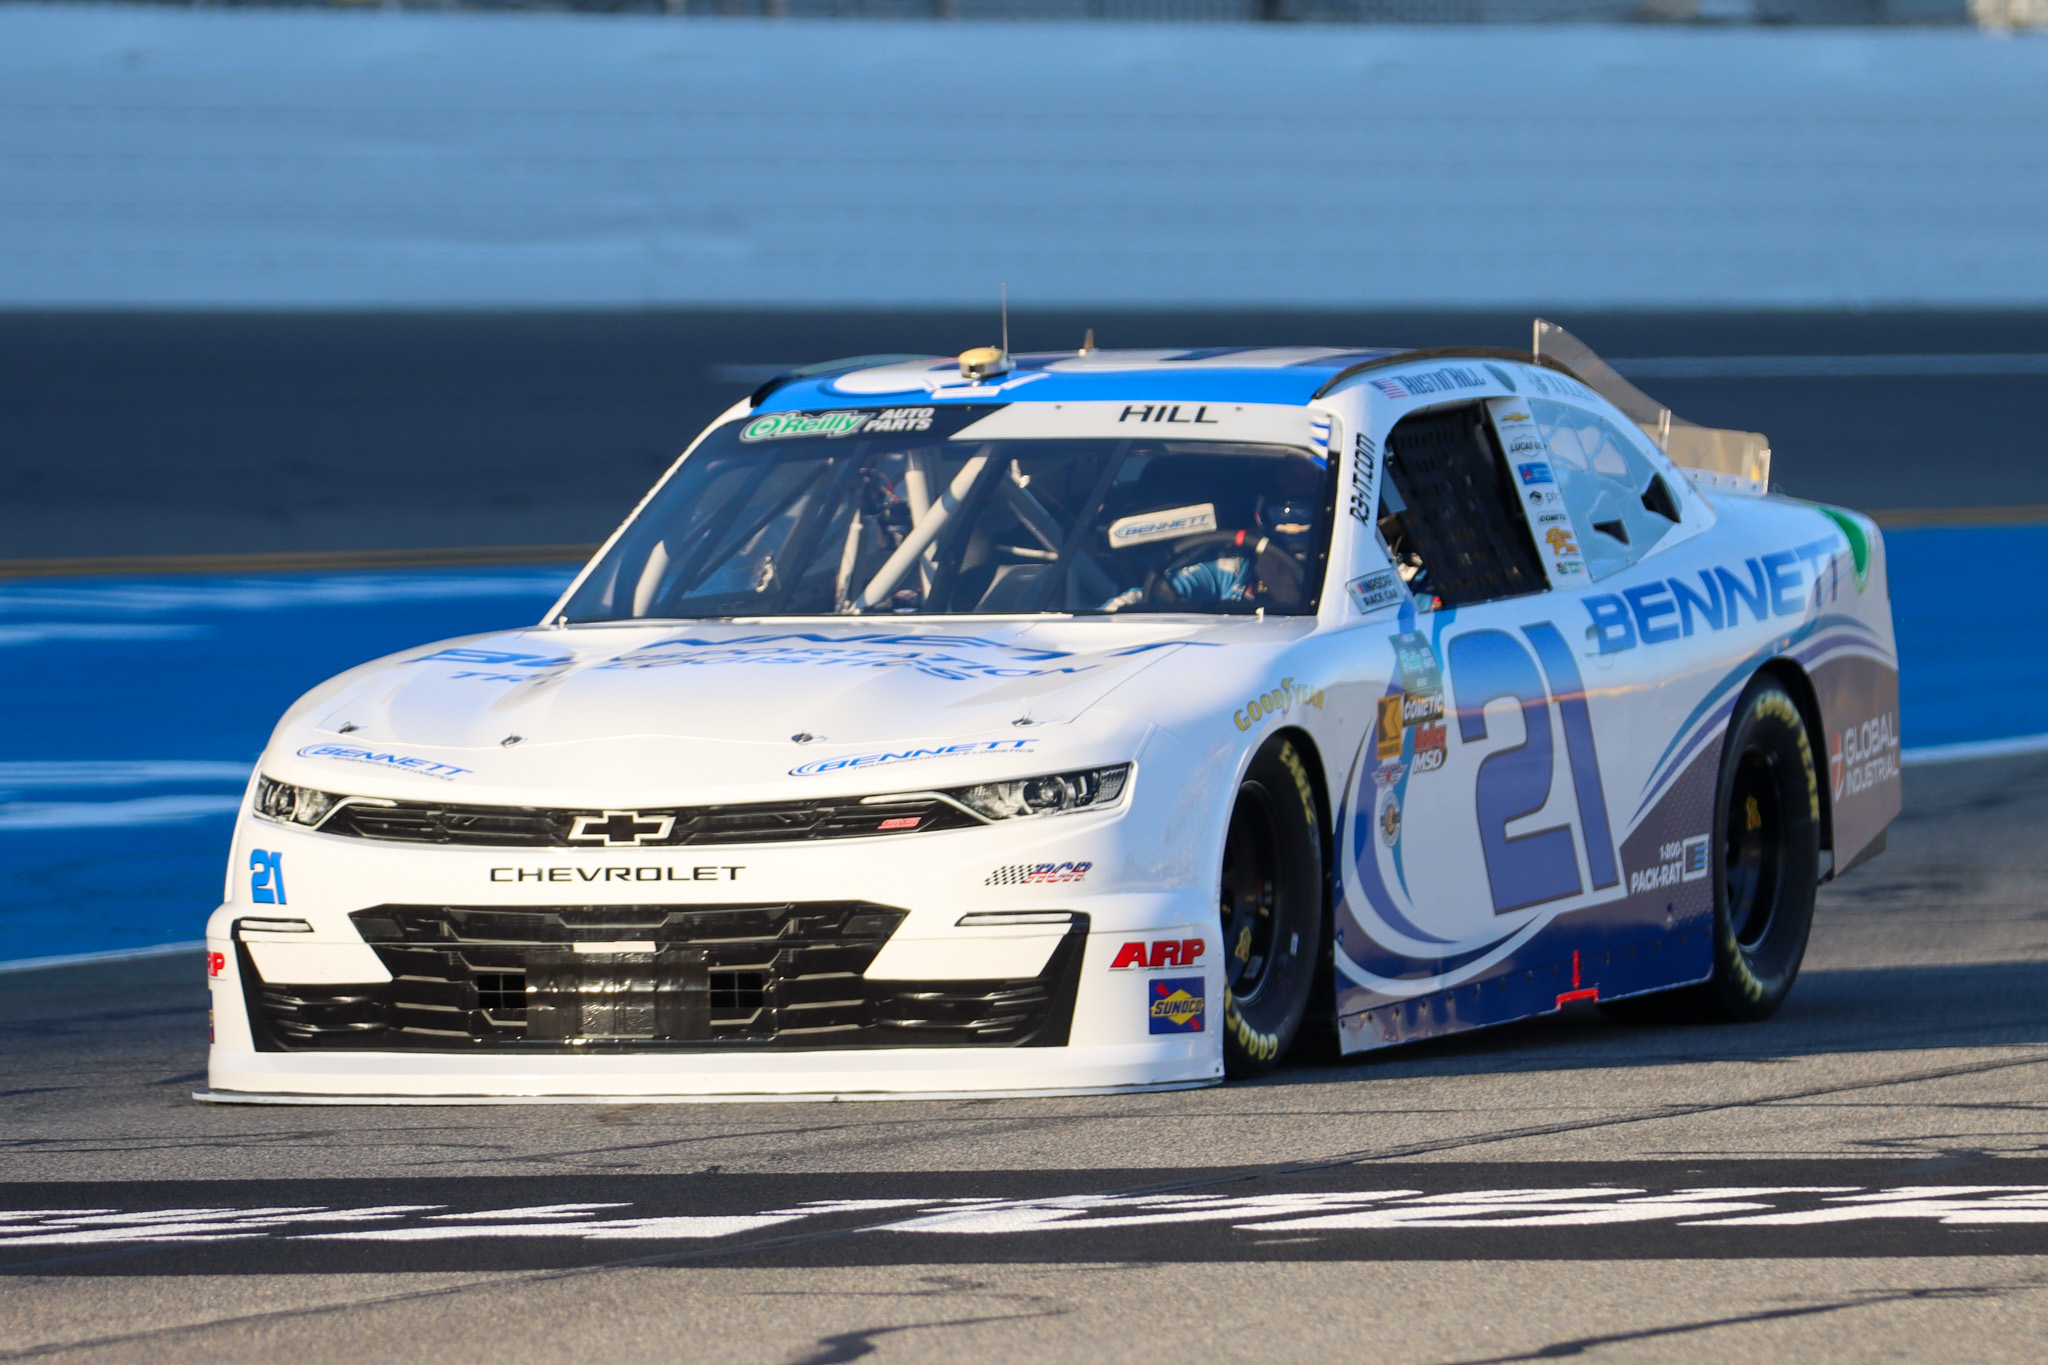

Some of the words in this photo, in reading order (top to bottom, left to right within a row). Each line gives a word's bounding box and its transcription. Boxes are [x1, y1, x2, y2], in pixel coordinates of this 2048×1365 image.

[746, 411, 870, 439] O'Reilly
[862, 418, 933, 432] PARTS
[878, 407, 935, 420] AUTO
[1118, 405, 1219, 424] HILL
[1510, 441, 1534, 452] LUCAS
[1125, 514, 1211, 536] BENNETT
[1363, 592, 1385, 607] RACE
[1580, 535, 1840, 655] BENNETT
[1234, 677, 1325, 731] GOODYEAR
[1404, 694, 1444, 719] COMETIC
[1845, 712, 1898, 766] GLOBAL
[312, 745, 475, 775] BENNETT
[815, 739, 1040, 773] BENNETT
[1414, 748, 1443, 774] MSD
[1447, 619, 1620, 916] 21
[1846, 751, 1899, 797] INDUSTRIAL
[250, 849, 287, 905] 21
[490, 866, 747, 882] CHEVROLET
[1022, 861, 1093, 884] RCR
[1631, 861, 1683, 895] PACK-RAT
[1110, 938, 1206, 968] ARP
[1154, 999, 1204, 1015] SUNOCO
